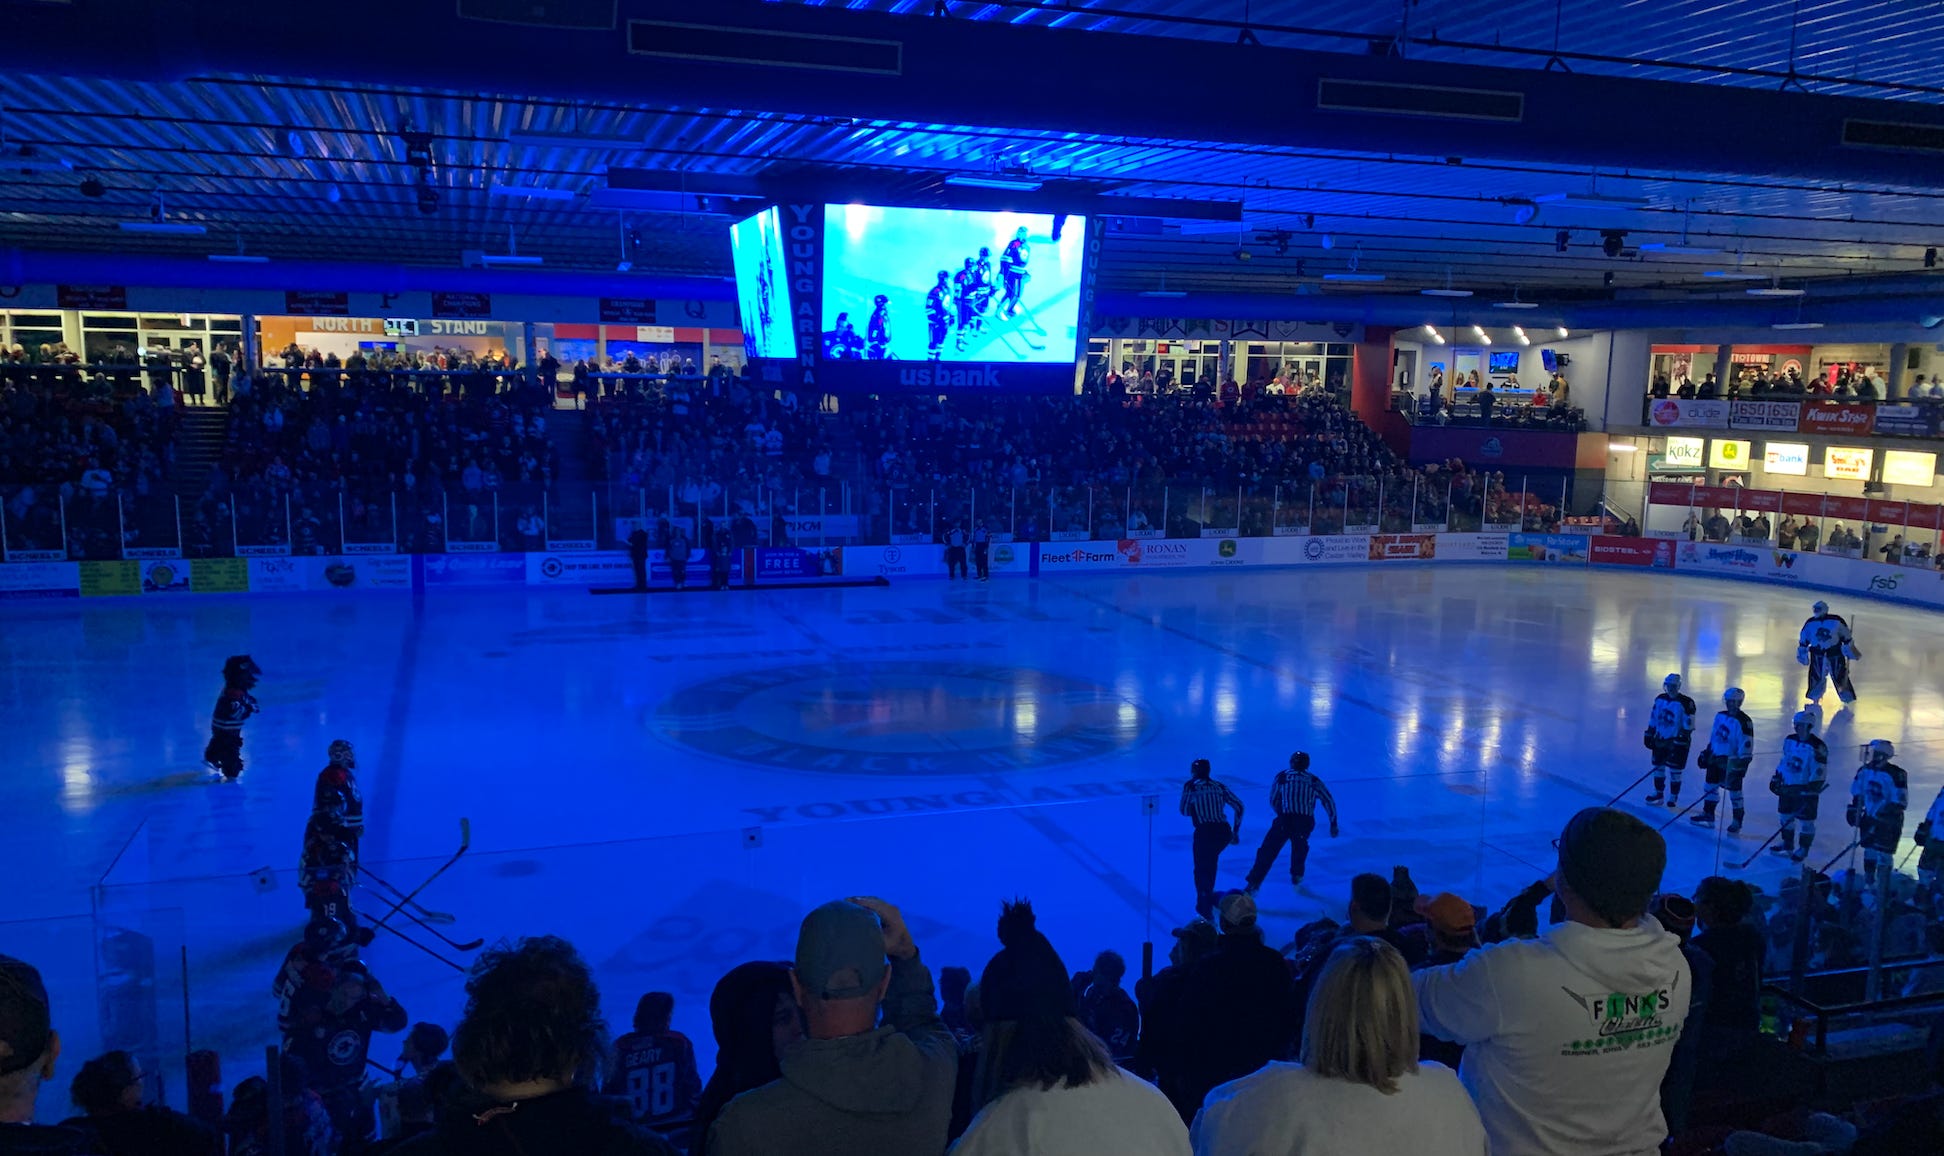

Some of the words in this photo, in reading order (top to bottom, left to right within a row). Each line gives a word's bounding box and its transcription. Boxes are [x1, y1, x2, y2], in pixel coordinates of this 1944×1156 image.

[790, 204, 815, 292] YOUNG
[312, 317, 372, 333] NORTH
[431, 320, 487, 335] STAND
[798, 302, 815, 384] ARENA
[936, 364, 1001, 387] bank
[1734, 403, 1766, 416] 1650
[1767, 403, 1798, 417] 1650
[1779, 452, 1803, 463] bank
[1147, 543, 1187, 553] RONAN
[1347, 551, 1366, 559] Valley
[1594, 546, 1639, 555] BIOSTEEL
[765, 558, 800, 569] FREE
[1042, 553, 1071, 563] Fleet
[1085, 552, 1114, 562] Farm
[1867, 575, 1898, 591] fsb
[740, 788, 998, 823] YOUNG
[1594, 988, 1671, 1019] FINKS
[625, 1047, 663, 1067] GEARY
[627, 1062, 675, 1118] 88
